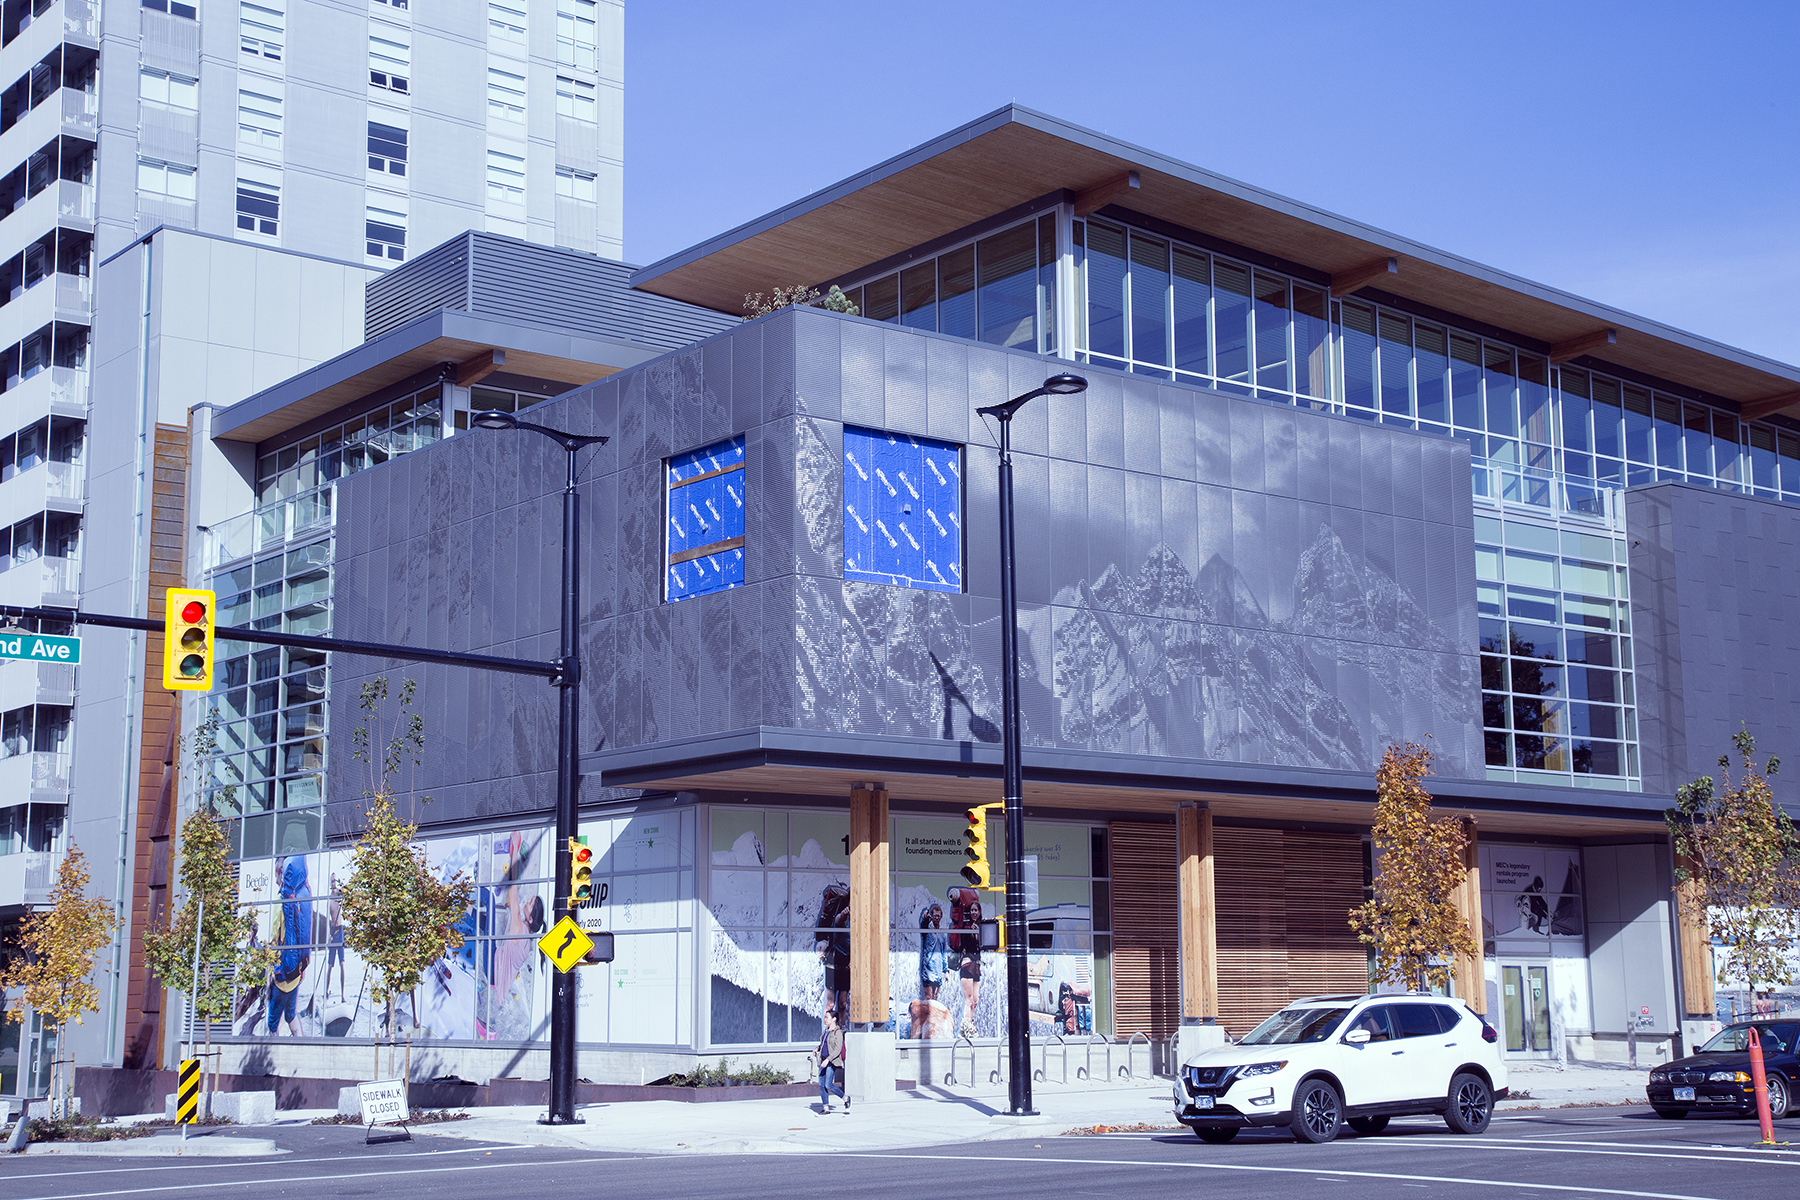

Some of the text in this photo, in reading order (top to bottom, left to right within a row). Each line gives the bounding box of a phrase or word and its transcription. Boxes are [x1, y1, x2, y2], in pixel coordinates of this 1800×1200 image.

[30, 639, 70, 659] Ave
[905, 847, 932, 855] founding
[587, 918, 602, 928] 2020
[362, 1088, 402, 1102] SIDEWALK
[370, 1101, 400, 1114] CLOSED
